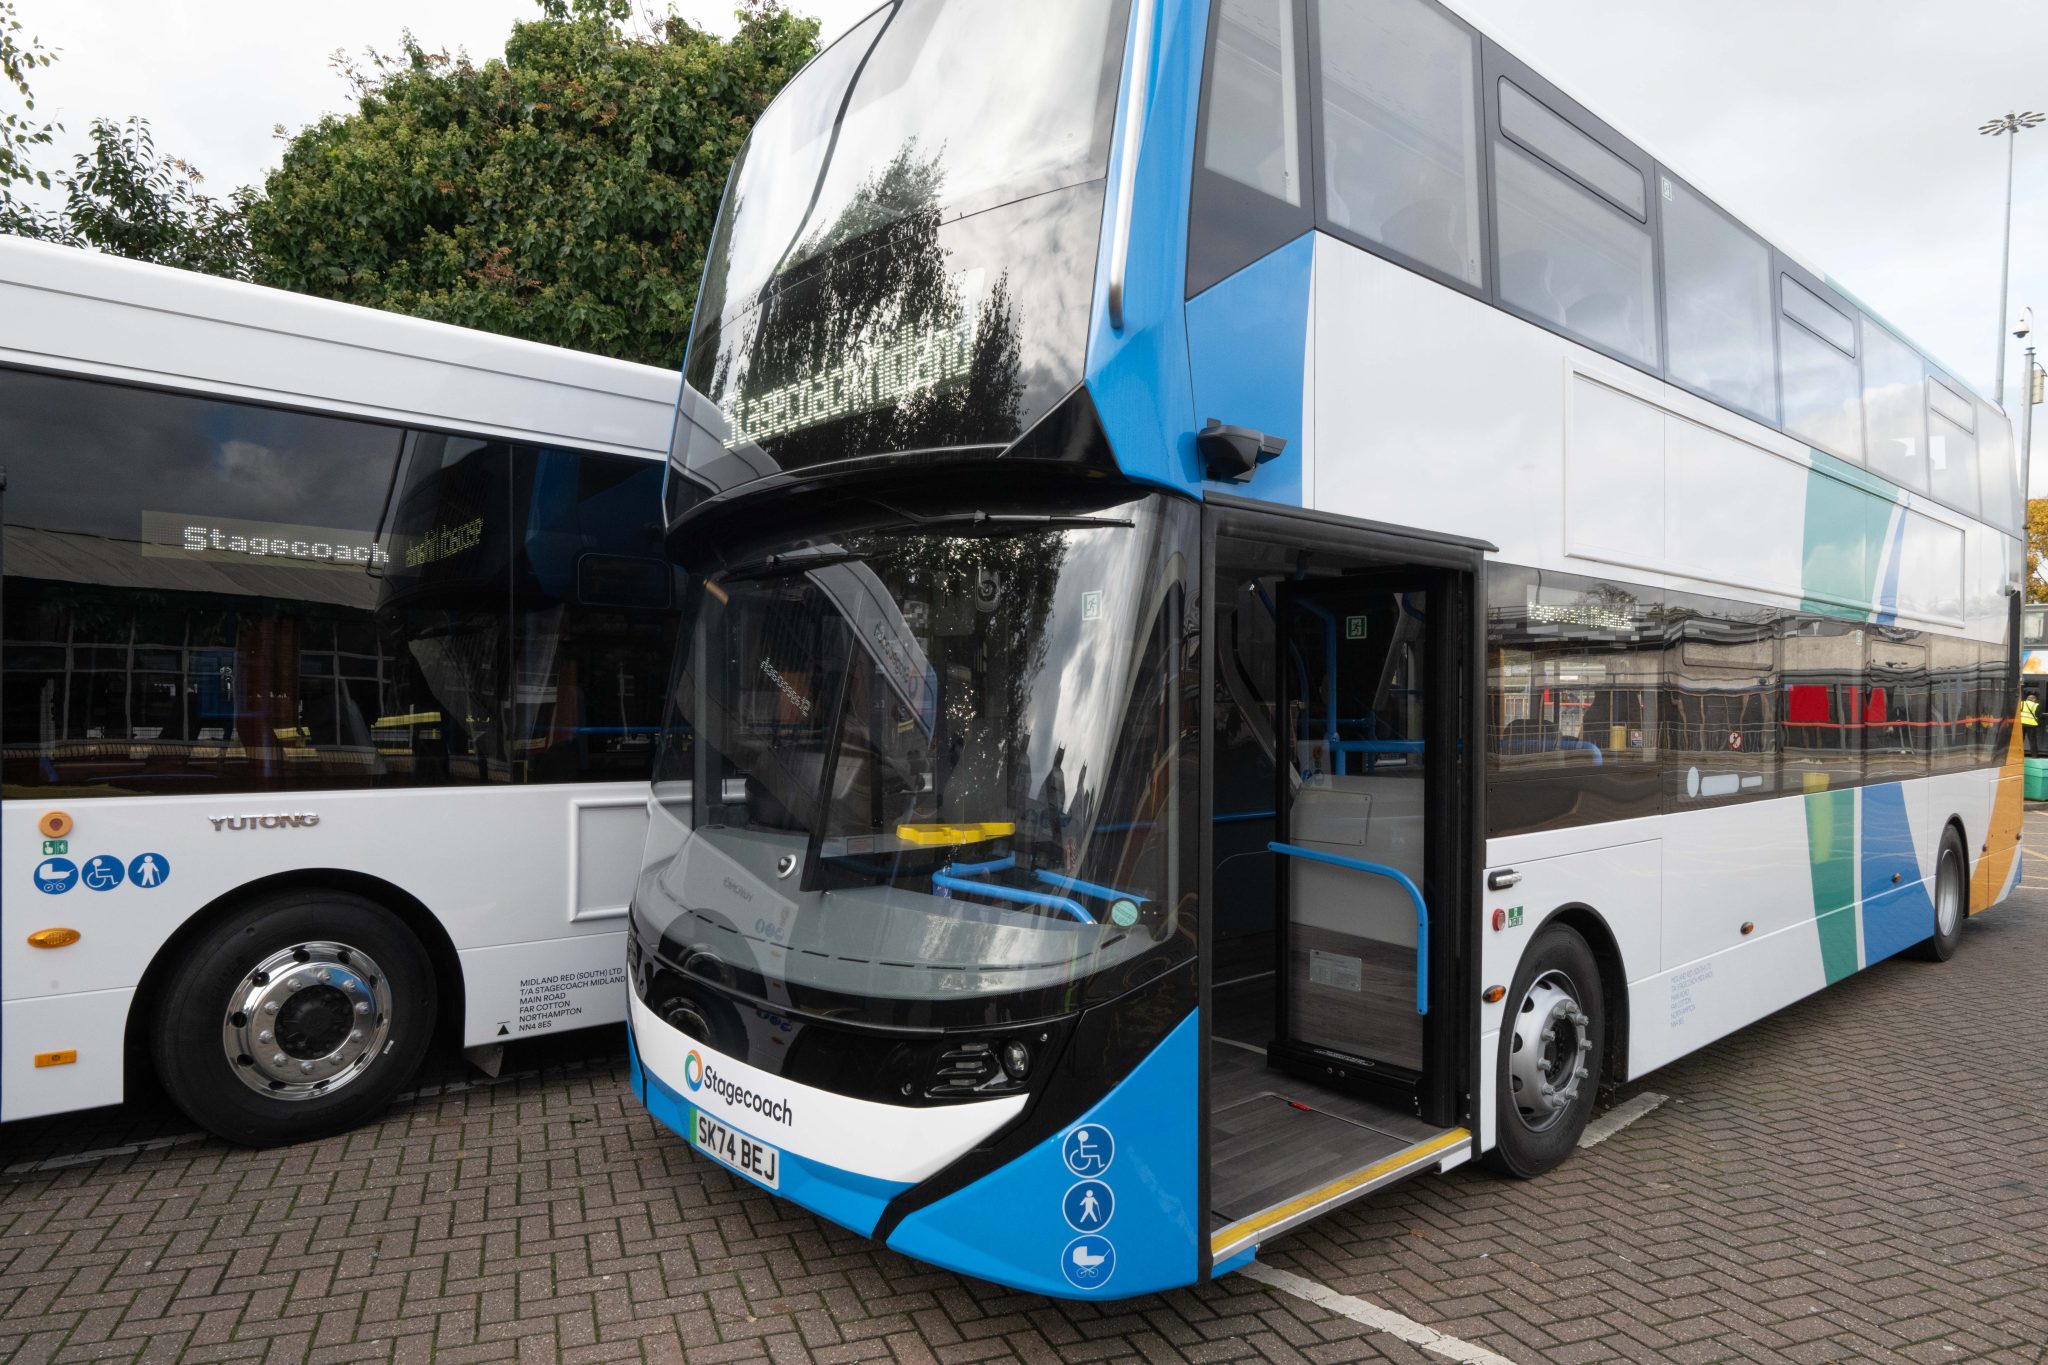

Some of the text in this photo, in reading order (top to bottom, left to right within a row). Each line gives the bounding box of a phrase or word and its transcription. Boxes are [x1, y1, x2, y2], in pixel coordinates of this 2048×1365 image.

[184, 526, 389, 563] Stagecoach
[208, 812, 320, 832] YUTONG
[520, 967, 622, 987] MIDLAND RED (SOUTH) LTD
[520, 988, 534, 996] T/A
[535, 981, 588, 993] STAGECOACH
[519, 1000, 571, 1014] FAR COTTON
[520, 992, 566, 1005] MAIN ROAD
[519, 1007, 582, 1023] NORTHAMPTON
[519, 1020, 552, 1032] NN4 8ES
[703, 1065, 793, 1127] Stagecoach
[698, 1116, 737, 1161] SK74
[740, 1138, 776, 1181] BEJ
